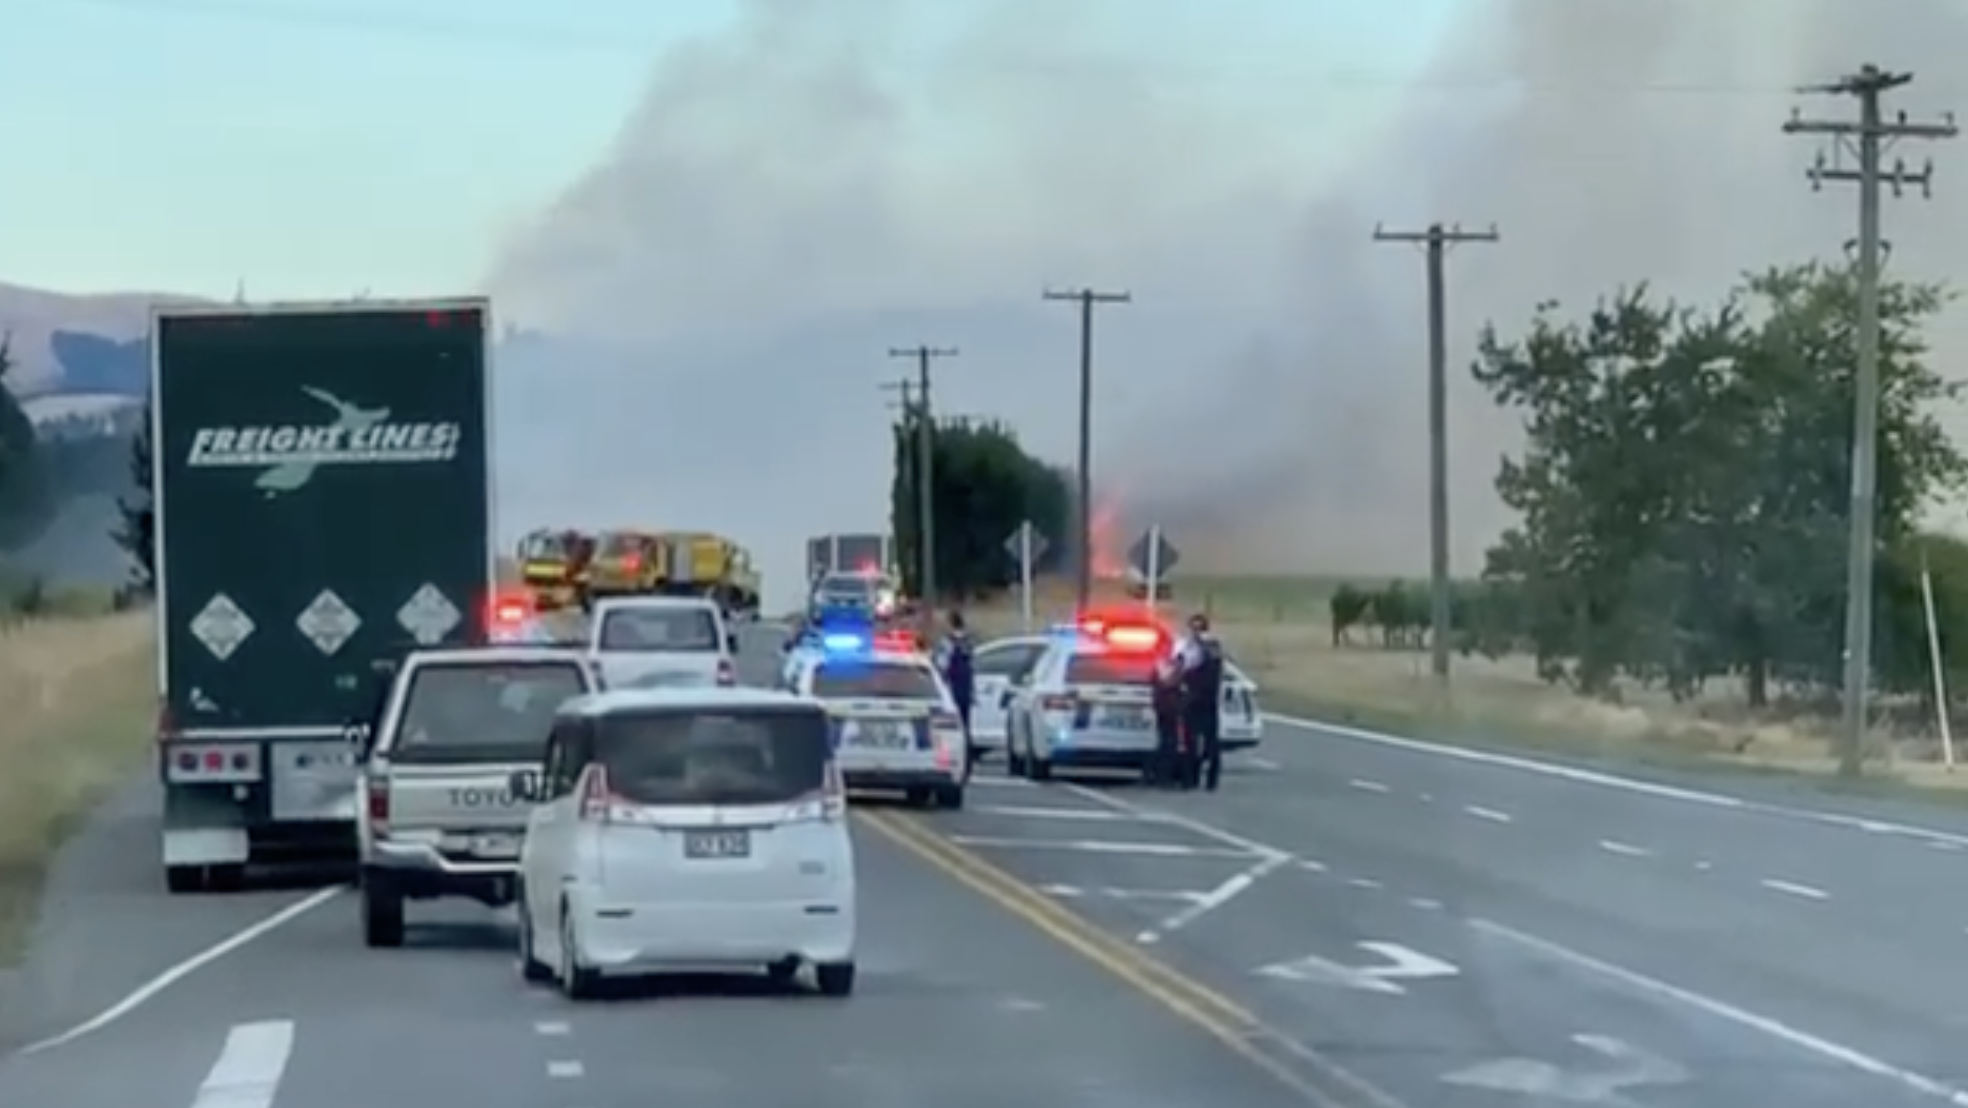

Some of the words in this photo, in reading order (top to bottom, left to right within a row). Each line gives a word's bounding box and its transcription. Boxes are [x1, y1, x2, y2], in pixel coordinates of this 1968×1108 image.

[188, 425, 346, 463] FREIGHT
[349, 422, 456, 450] LINES
[447, 787, 514, 807] TOYO
